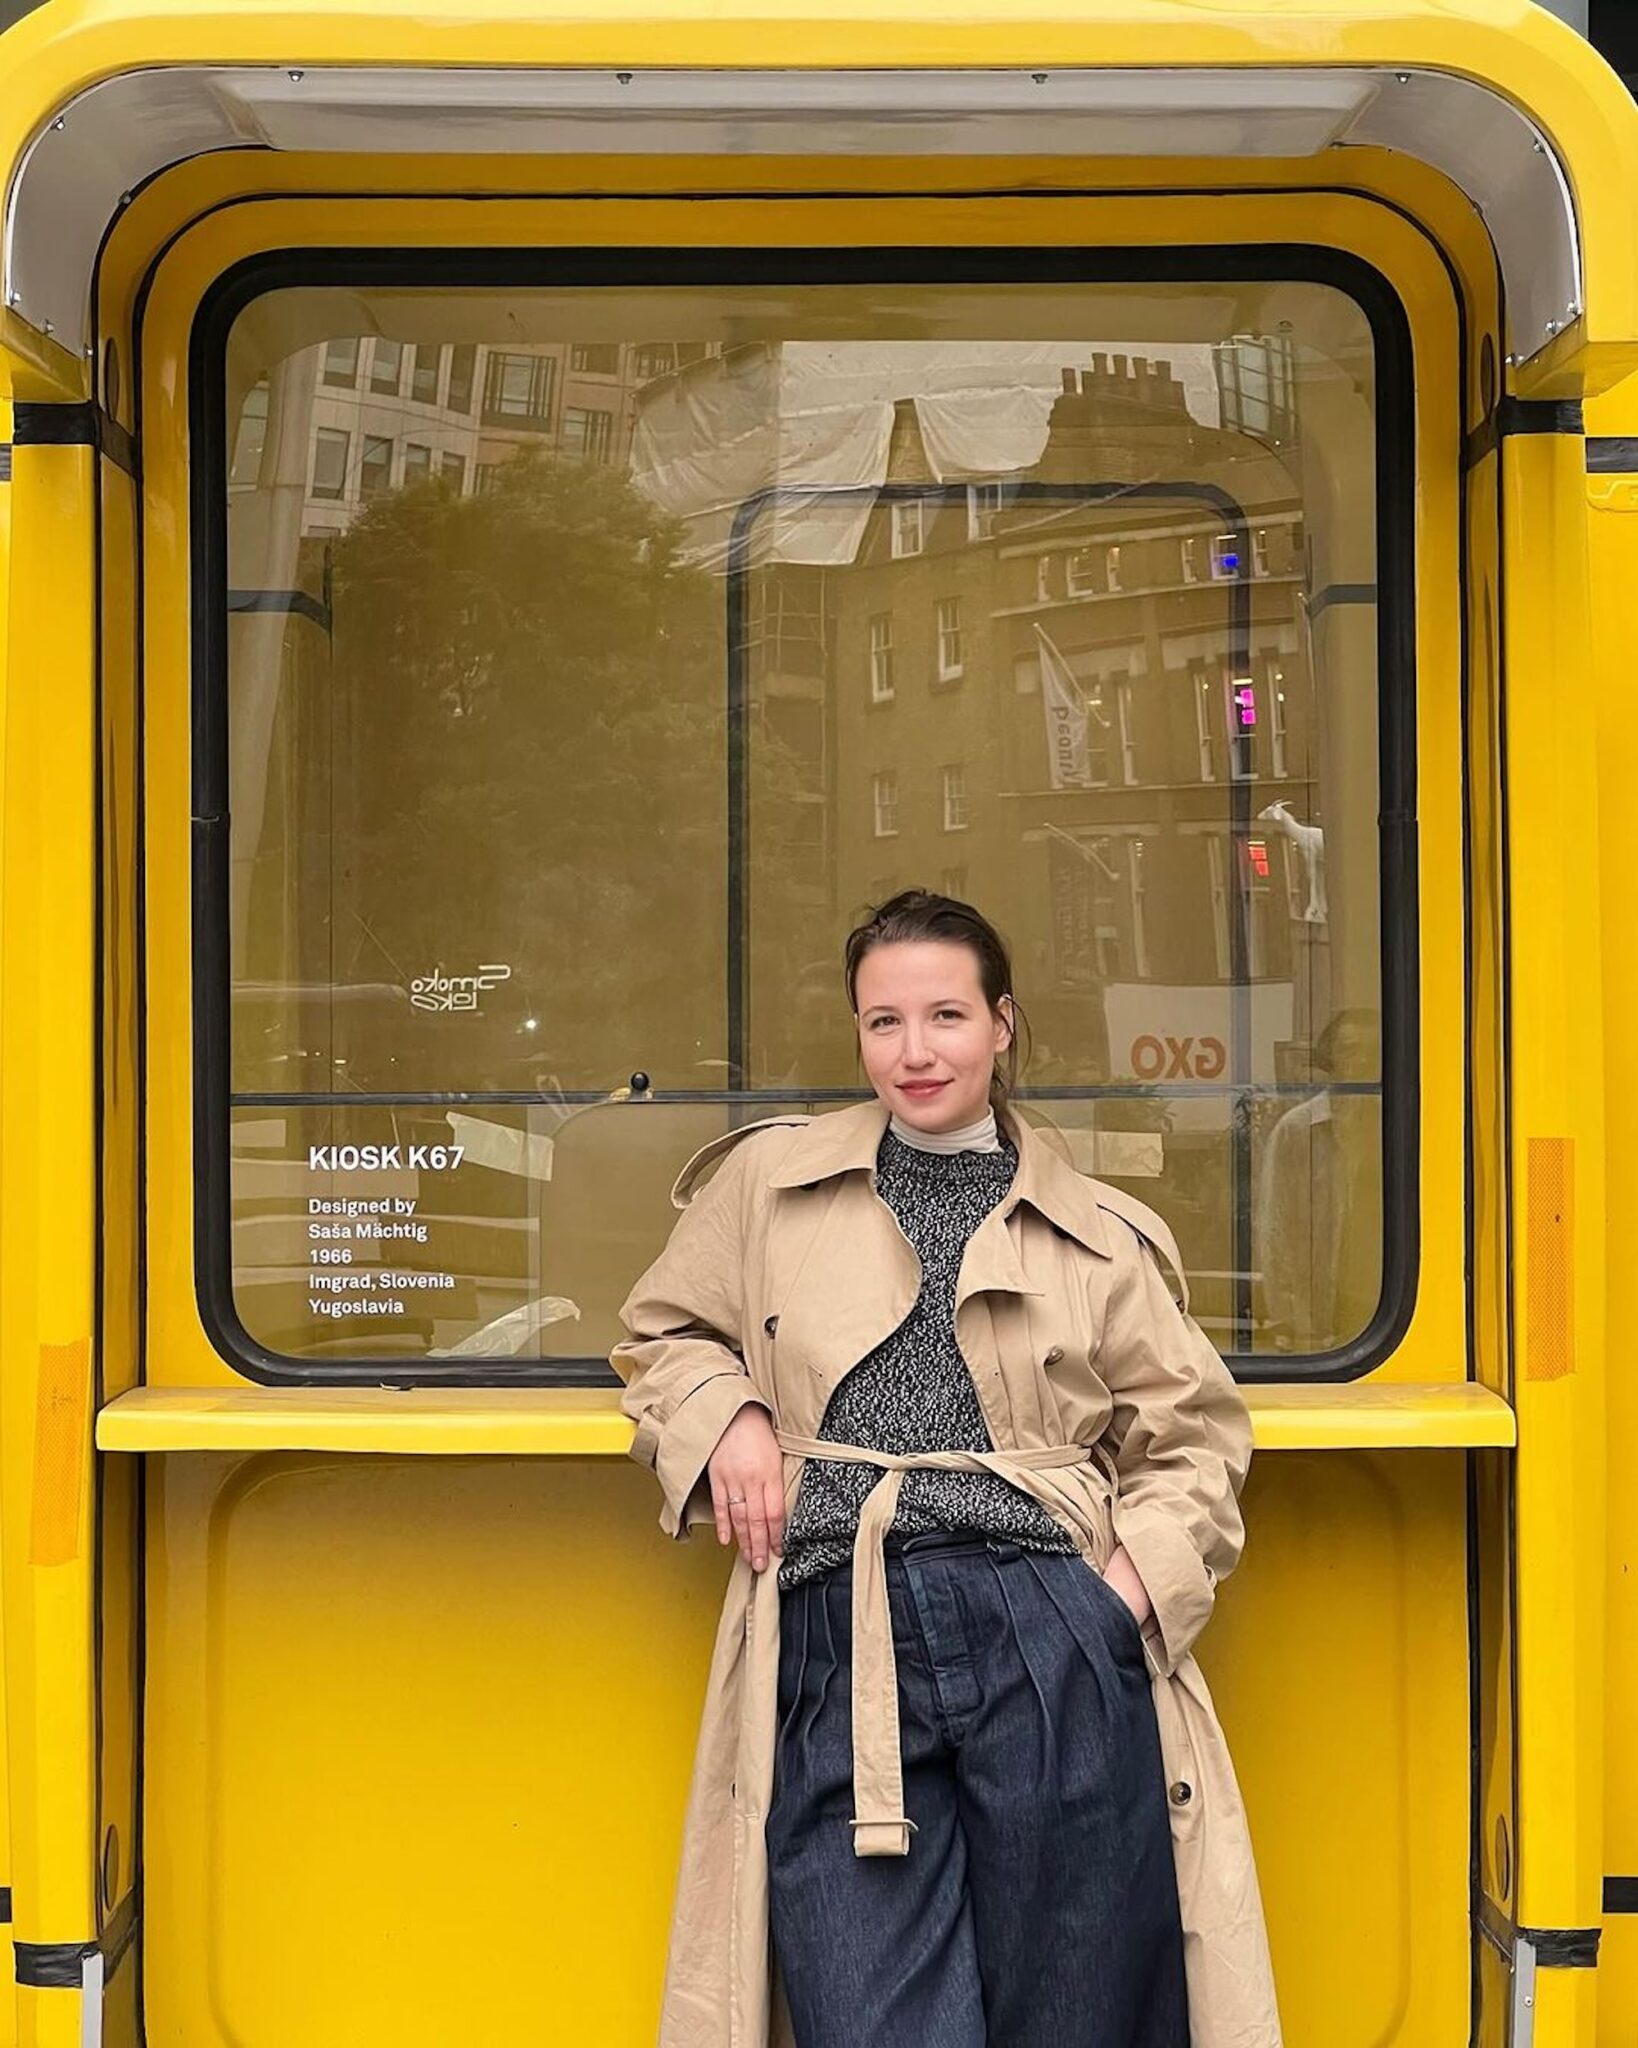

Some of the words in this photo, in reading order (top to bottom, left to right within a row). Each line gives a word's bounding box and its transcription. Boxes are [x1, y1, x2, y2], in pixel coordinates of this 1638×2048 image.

[309, 1146, 401, 1170] KIOSK
[409, 1146, 464, 1170] K67
[309, 1198, 390, 1217] Designed
[395, 1199, 416, 1217] by
[309, 1223, 351, 1239] Saša
[356, 1223, 427, 1242] Mächtig
[310, 1249, 352, 1264] 1966
[310, 1273, 376, 1292] Imgrad,
[379, 1273, 454, 1288] Slovenia
[309, 1298, 404, 1318] Yugoslavia
